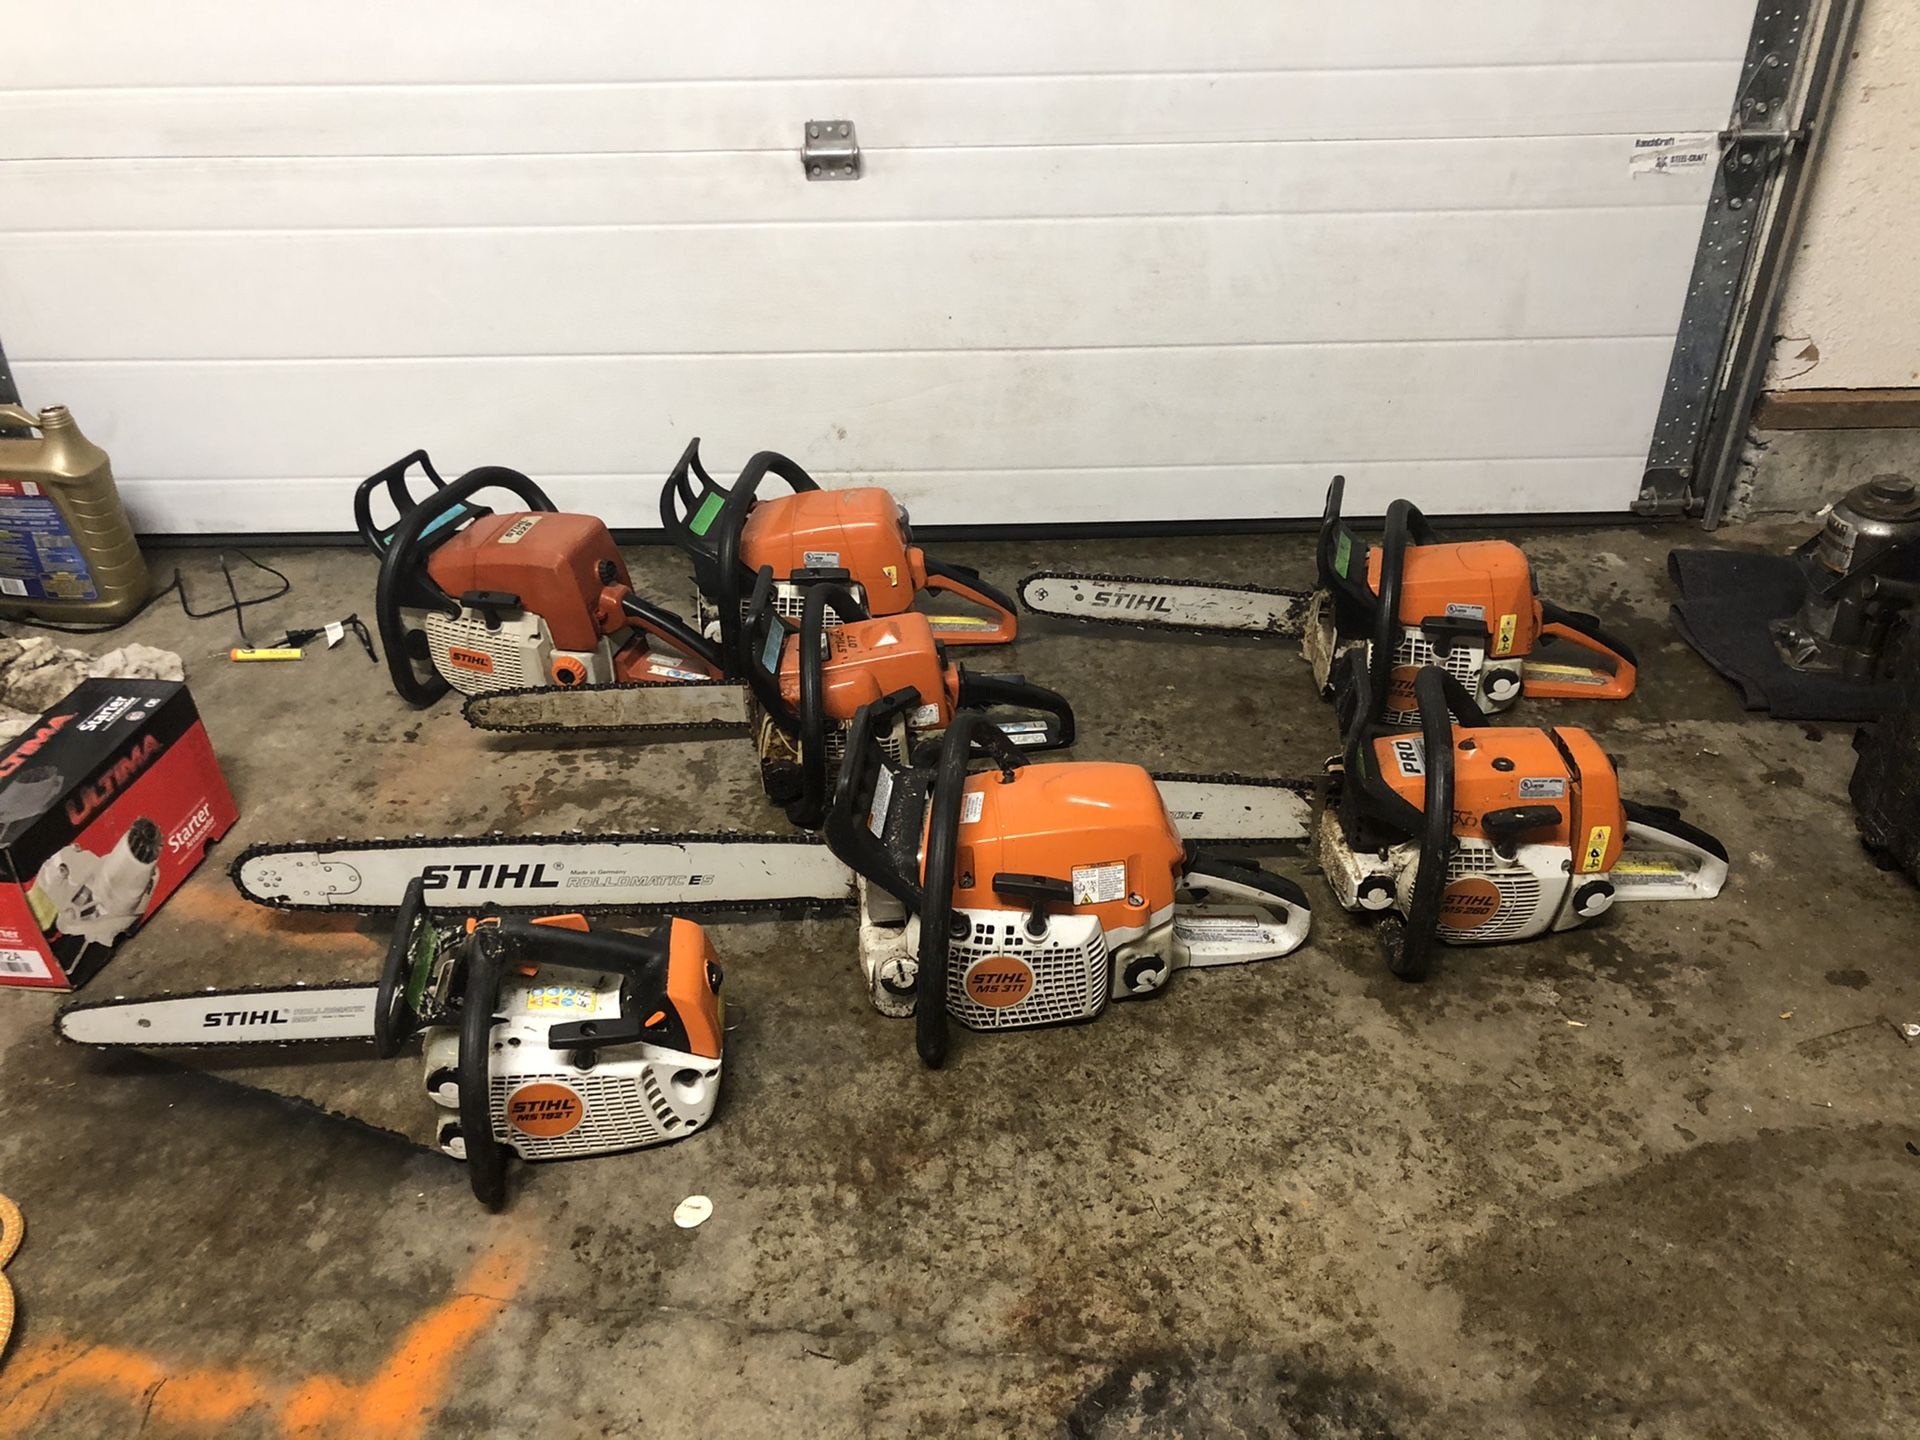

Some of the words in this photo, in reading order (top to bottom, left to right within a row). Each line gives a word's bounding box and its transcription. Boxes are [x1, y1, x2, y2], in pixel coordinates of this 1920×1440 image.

[1091, 592, 1171, 612] STIHL
[453, 652, 488, 667] STIHL
[79, 696, 127, 731] Starter
[1395, 741, 1421, 773] PRO
[66, 735, 161, 825] ULTIMA
[168, 803, 210, 853] Starter
[423, 864, 559, 889] STIHL
[566, 876, 687, 888] ROLLOMATIC
[1443, 895, 1494, 906] STIHL
[1441, 906, 1462, 914] MS
[1463, 907, 1490, 915] 260
[972, 973, 1027, 984] STIHL
[976, 985, 1000, 993] MS
[1001, 984, 1025, 993] 311
[203, 1010, 289, 1028] STIHL
[512, 1098, 575, 1114] STIHL
[517, 1113, 538, 1121] MS
